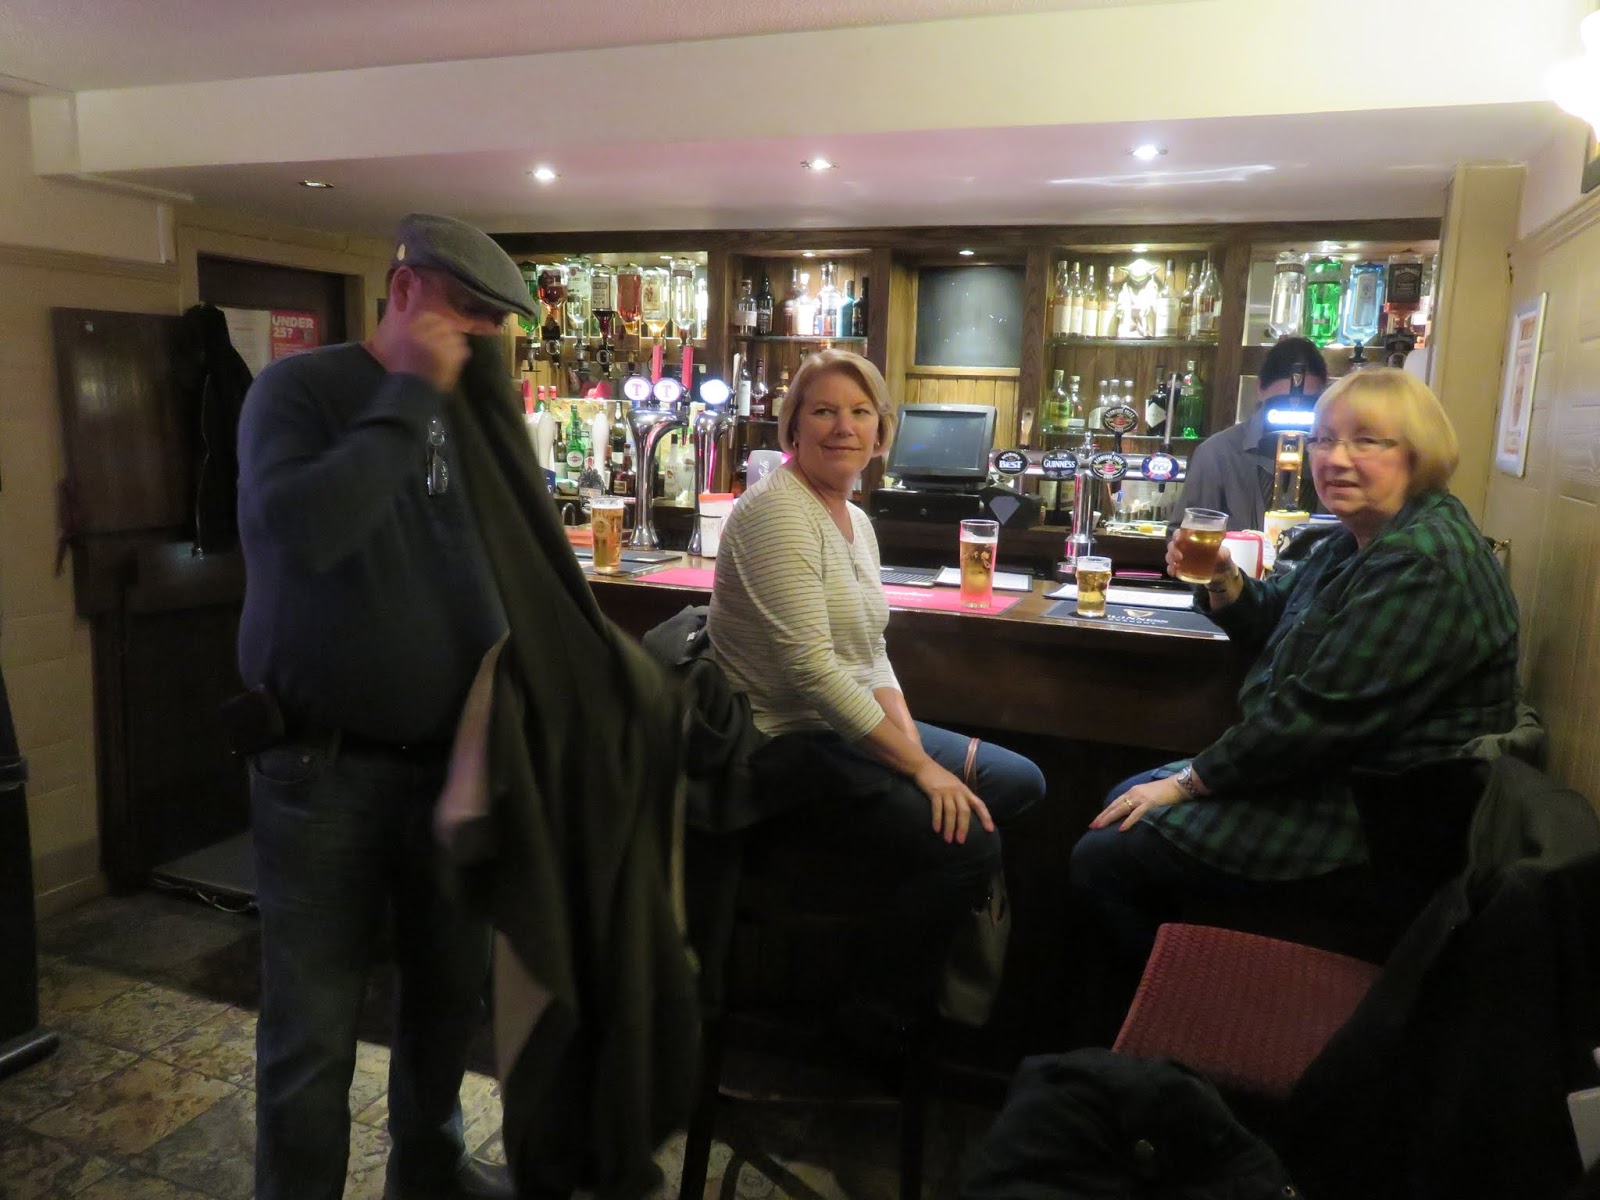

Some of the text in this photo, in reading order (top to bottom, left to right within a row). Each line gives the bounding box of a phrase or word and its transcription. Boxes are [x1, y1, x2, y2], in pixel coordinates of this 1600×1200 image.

[271, 316, 314, 329] UNDER
[273, 326, 294, 338] 25?
[631, 383, 642, 396] T
[661, 384, 672, 398] T
[1043, 459, 1076, 468] GUINNESS
